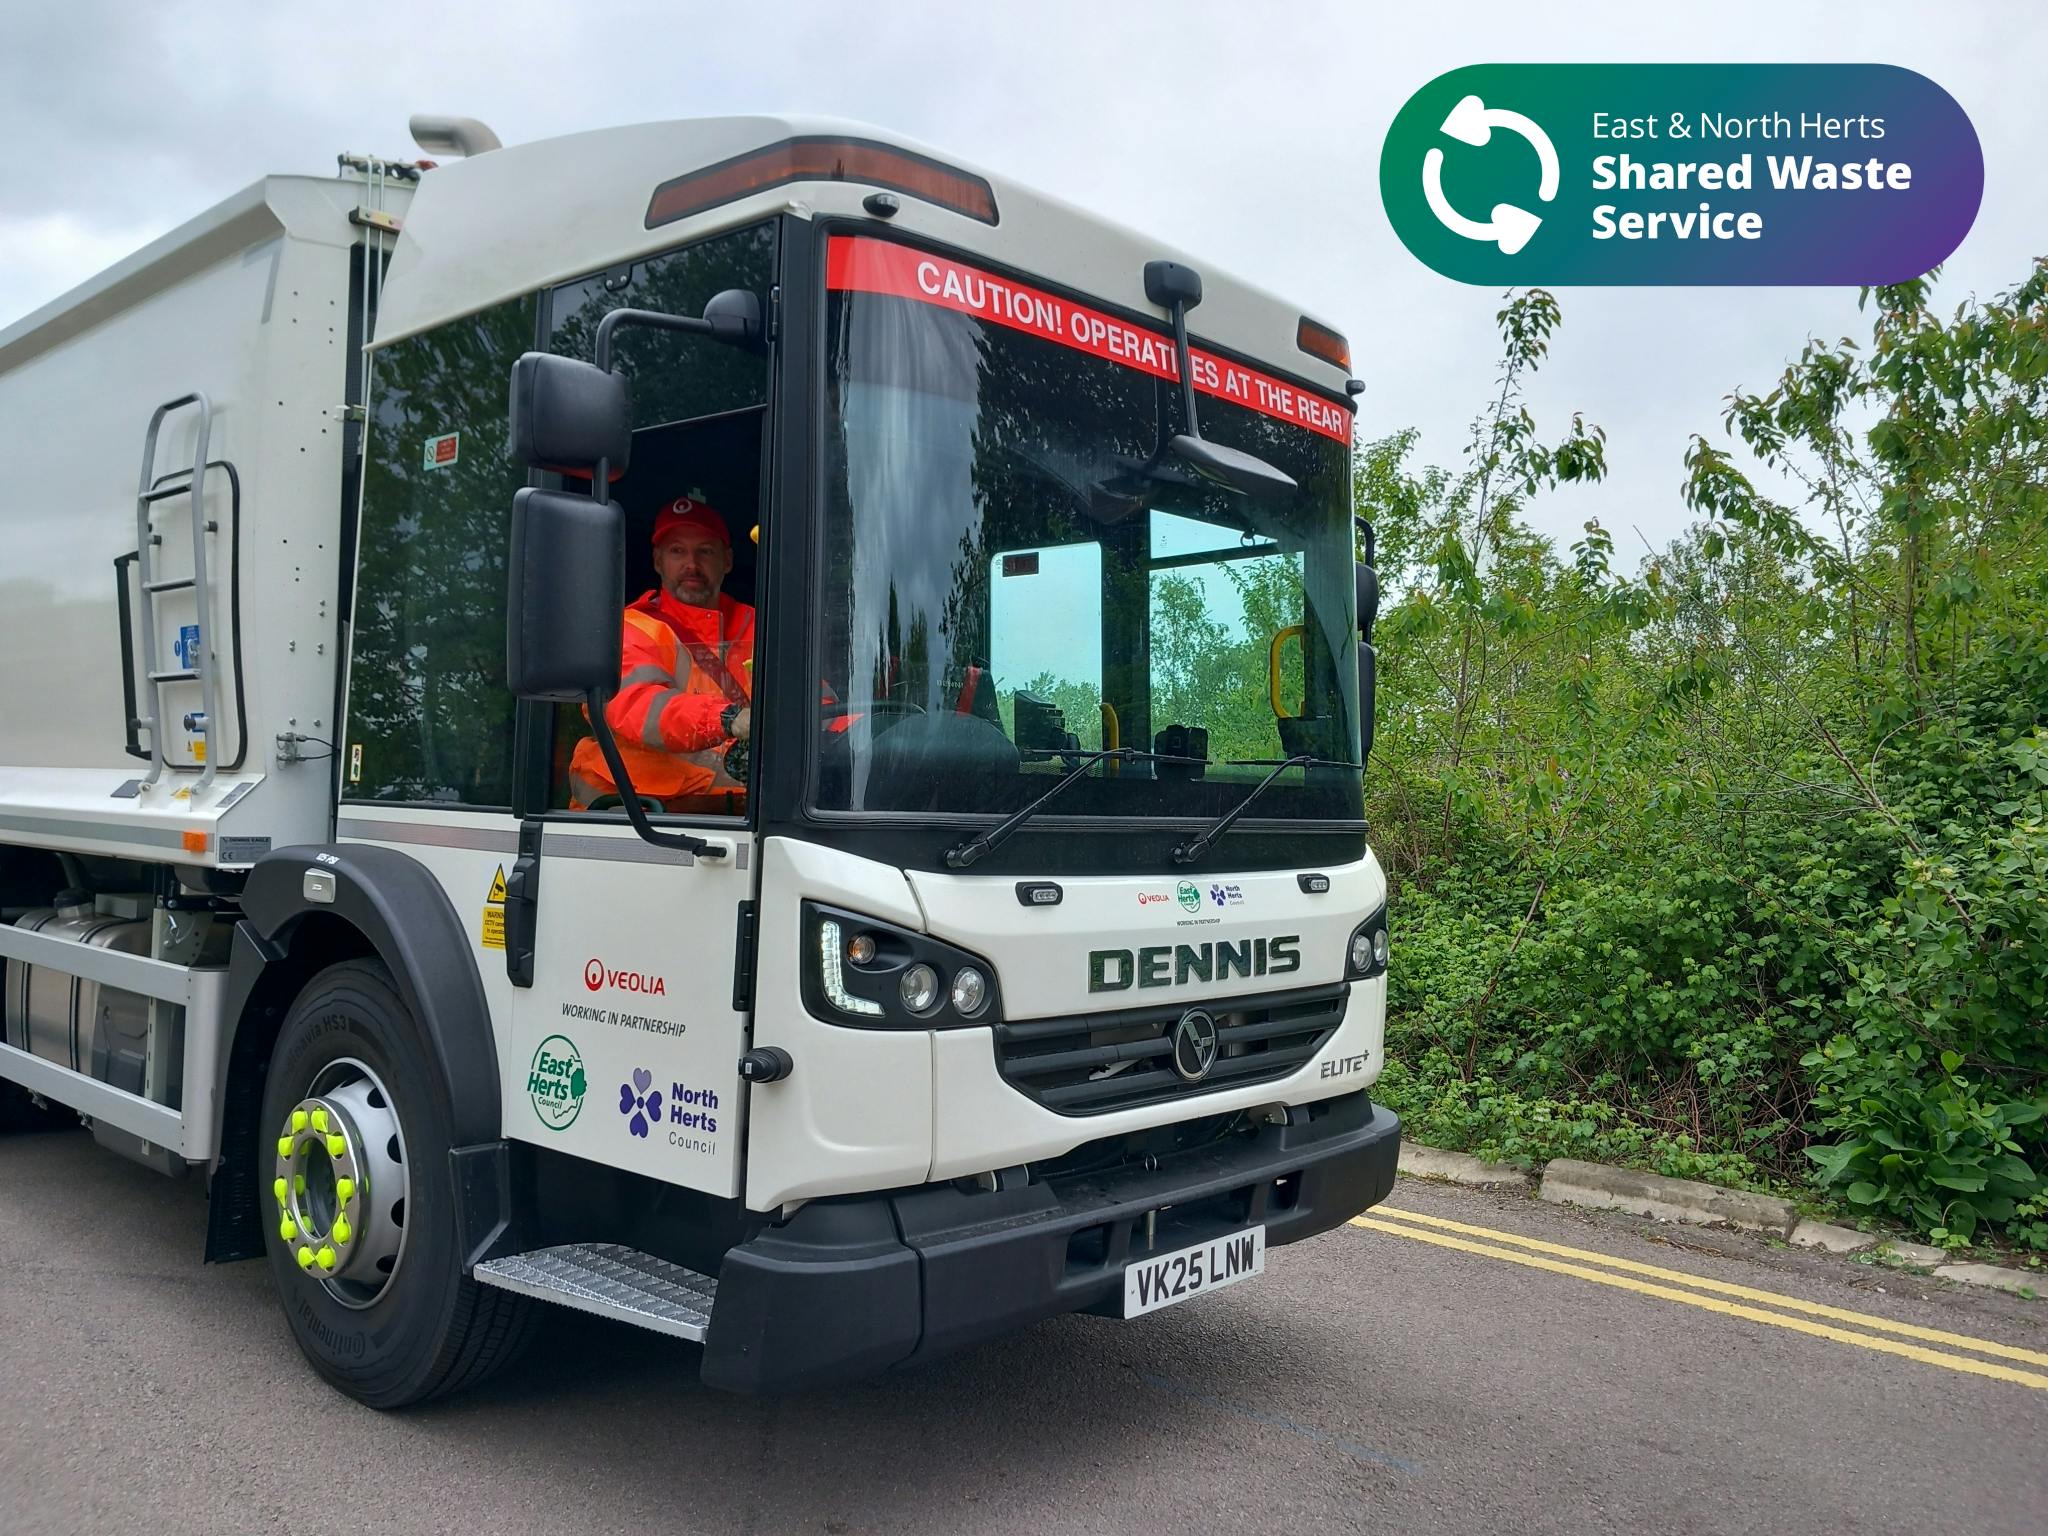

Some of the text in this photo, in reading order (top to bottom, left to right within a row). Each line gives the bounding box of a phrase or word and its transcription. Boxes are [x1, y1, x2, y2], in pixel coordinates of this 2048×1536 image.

[917, 261, 1344, 436] CAUTION! OPERATIES AT THE REAR
[1180, 887, 1193, 895] East
[1088, 935, 1300, 993] DENNIS
[607, 969, 666, 996] VEOLIA
[562, 1002, 686, 1038] WORKING IN PARTNERSHIP
[538, 1051, 573, 1078] East
[527, 1071, 569, 1101] Herts
[671, 1082, 719, 1110] North
[537, 1096, 563, 1110] Council
[670, 1104, 717, 1133] Herts
[668, 1131, 716, 1155] Council
[1137, 1234, 1254, 1306] VK25 LNW
[297, 1298, 366, 1359] Continental
